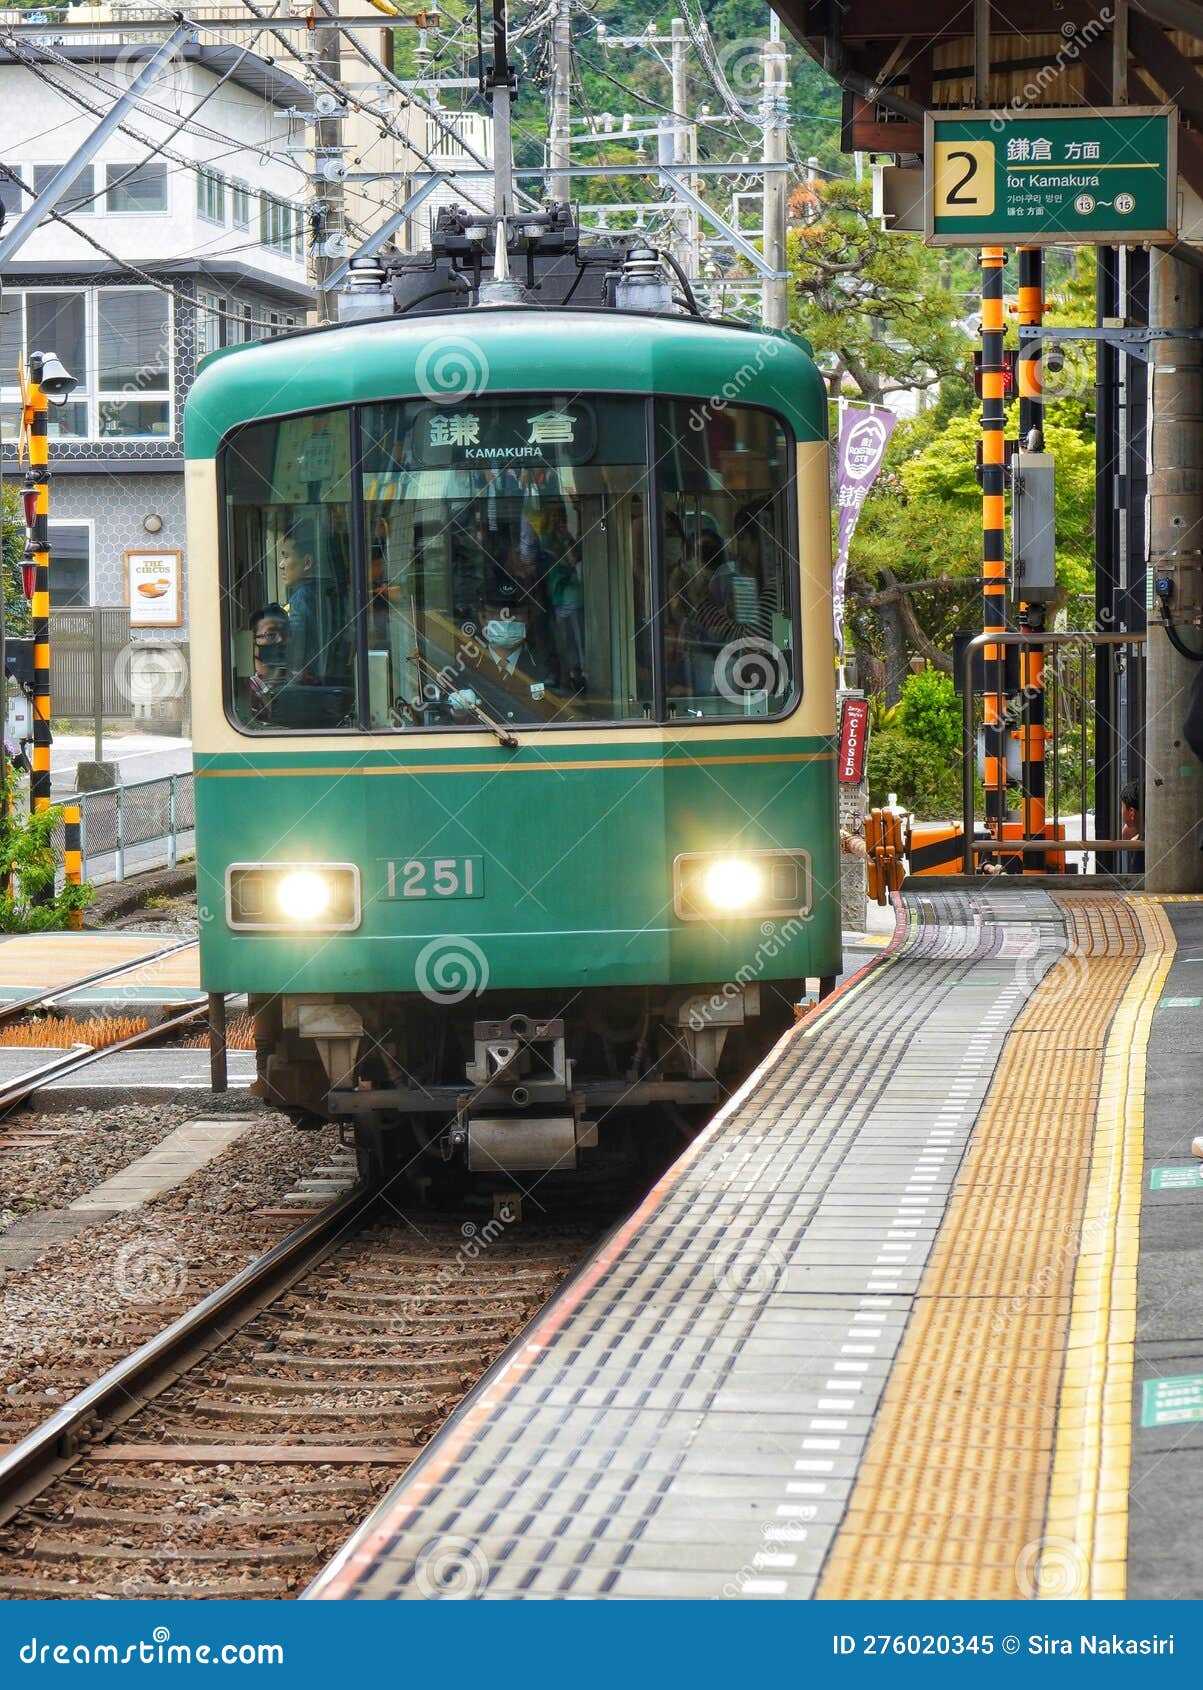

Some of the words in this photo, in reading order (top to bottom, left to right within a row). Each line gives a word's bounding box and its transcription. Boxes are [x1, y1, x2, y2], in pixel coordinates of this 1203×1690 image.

[1007, 138, 1052, 161] 鎌倉
[1064, 141, 1100, 160] 方面
[946, 151, 978, 205] 2
[1007, 175, 1025, 188] for
[1029, 174, 1099, 187] Kamakura
[428, 411, 577, 447] 鎌倉
[465, 447, 543, 458] KAMAKURA
[844, 719, 859, 776] CLOSED
[388, 860, 473, 896] 1251
